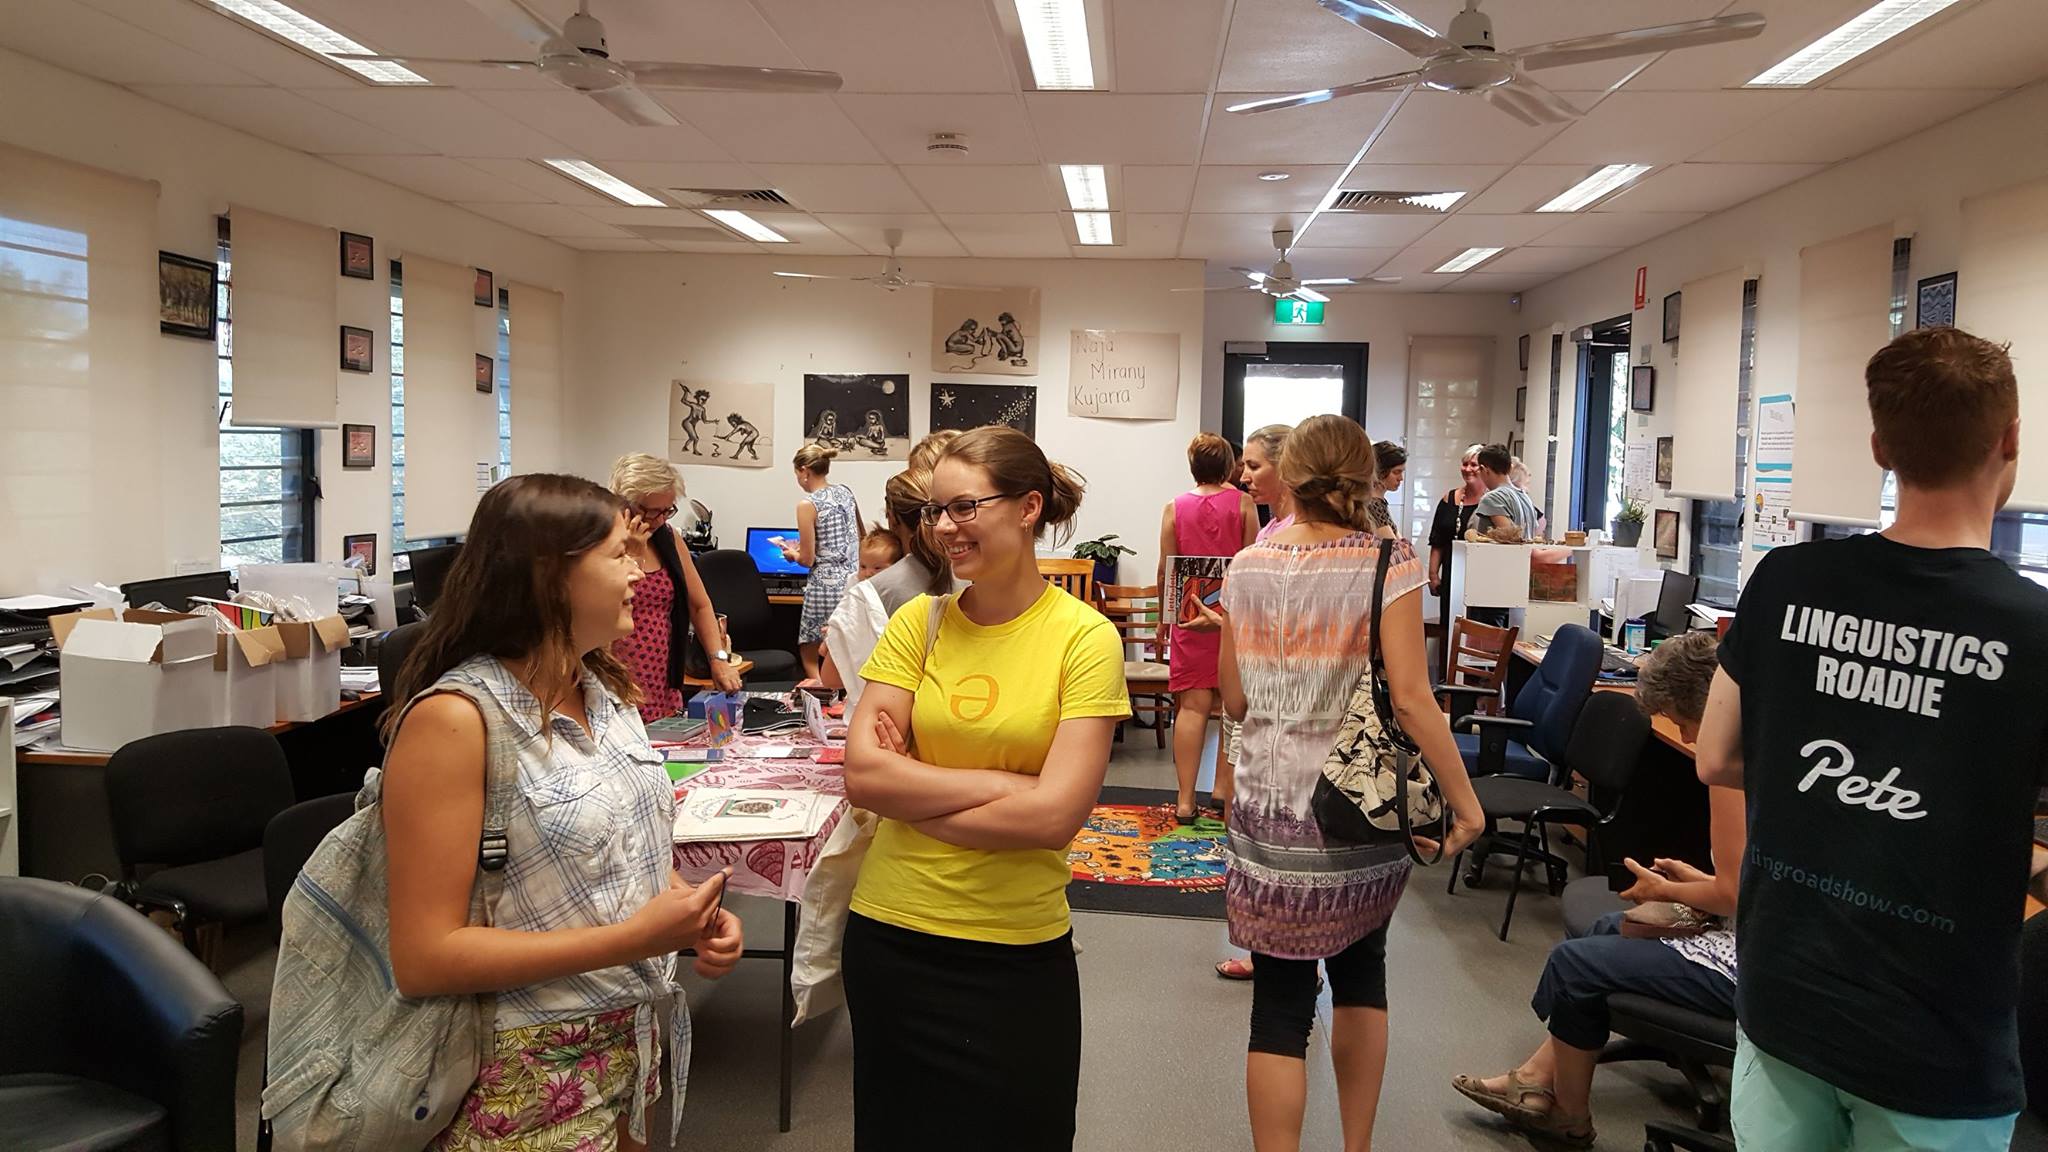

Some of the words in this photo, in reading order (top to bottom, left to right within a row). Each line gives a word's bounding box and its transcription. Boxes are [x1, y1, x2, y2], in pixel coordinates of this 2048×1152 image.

[1073, 385, 1131, 414] Kujarra
[1091, 362, 1146, 390] Mirany
[1781, 604, 2009, 681] LINGUISTICS
[1815, 655, 1946, 718] ROADIE
[1797, 739, 1928, 820] Pete
[1750, 844, 1956, 933] lingroadshow.com
